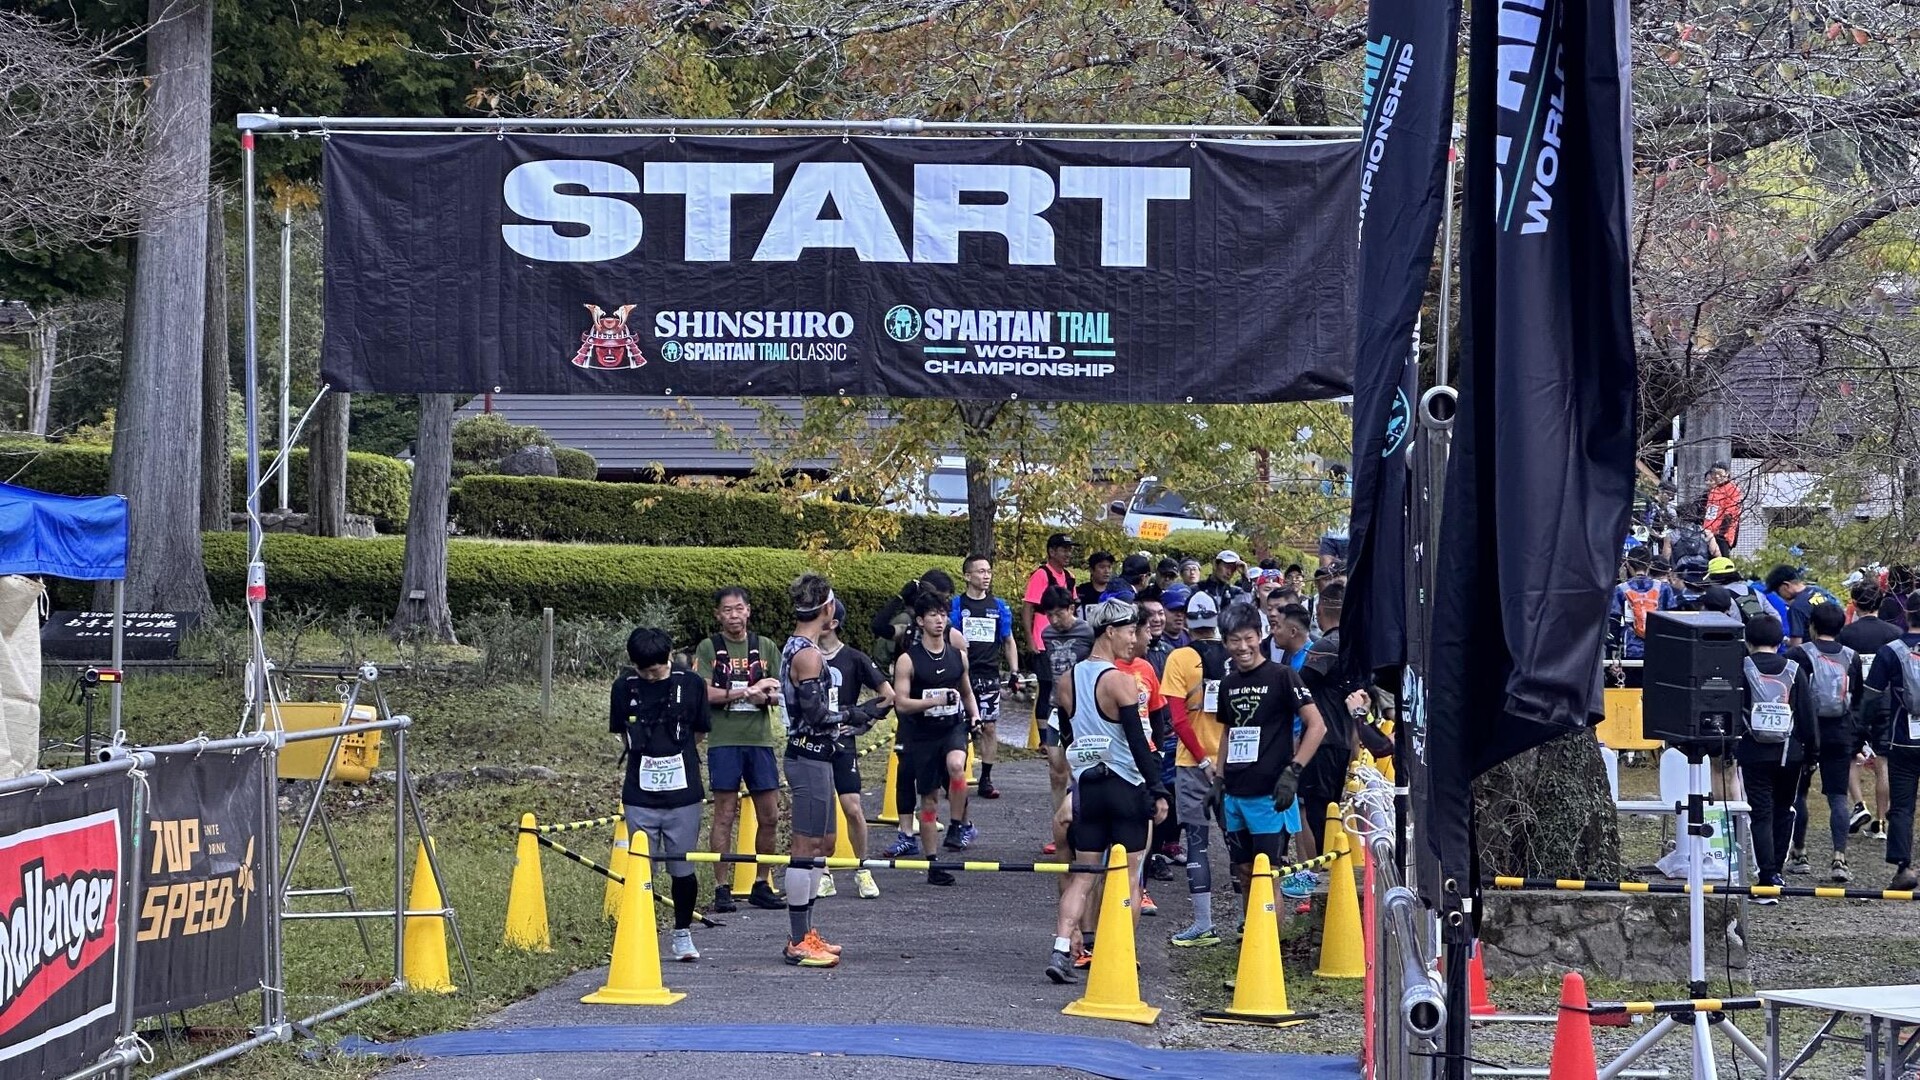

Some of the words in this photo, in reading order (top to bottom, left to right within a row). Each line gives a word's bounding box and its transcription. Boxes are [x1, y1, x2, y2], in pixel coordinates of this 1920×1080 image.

[502, 160, 1191, 267] START
[655, 311, 854, 338] SHINSHIRO
[924, 308, 1051, 343] SPARTAN
[1057, 311, 1114, 343] TRAIL
[684, 342, 755, 361] SPARTAN
[974, 345, 1066, 359] WORLD
[924, 360, 1115, 377] CHAMPIONSHIP
[1760, 714, 1782, 725] 713
[1077, 751, 1101, 762] 585
[1233, 742, 1249, 755] 771
[651, 771, 675, 785] 527
[150, 818, 200, 874] TOP
[136, 877, 236, 942] SPEED
